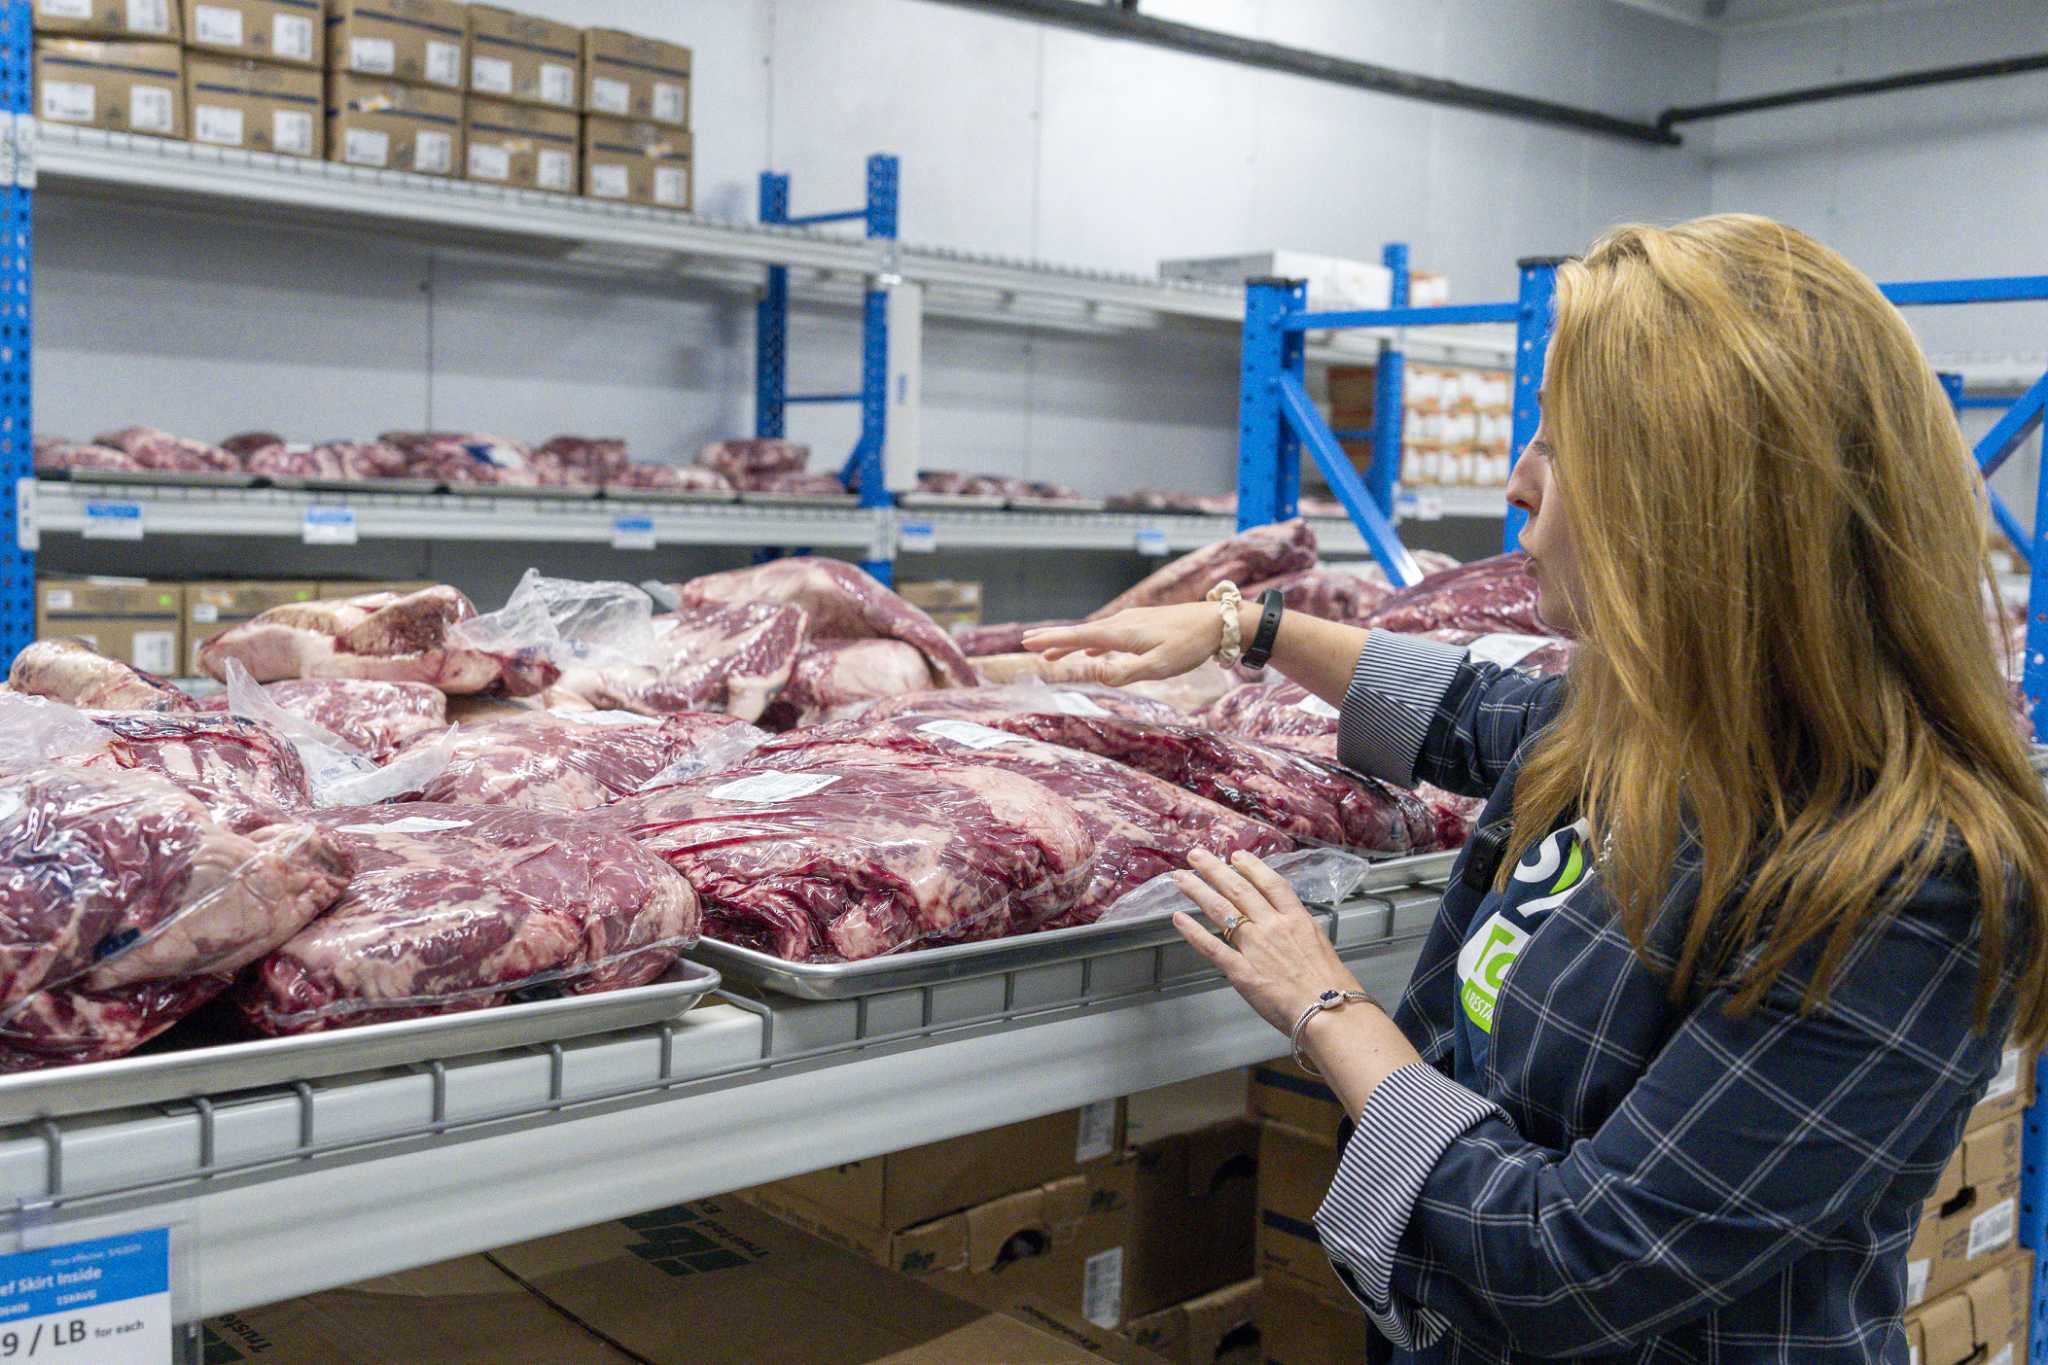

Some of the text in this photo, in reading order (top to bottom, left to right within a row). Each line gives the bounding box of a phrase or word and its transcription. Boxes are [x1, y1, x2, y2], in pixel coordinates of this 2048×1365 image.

[18, 1275, 54, 1293] Skirt
[57, 1266, 102, 1285] Inside
[28, 1323, 43, 1357] /
[53, 1319, 86, 1346] LB
[95, 1328, 111, 1338] for
[115, 1320, 144, 1334] each
